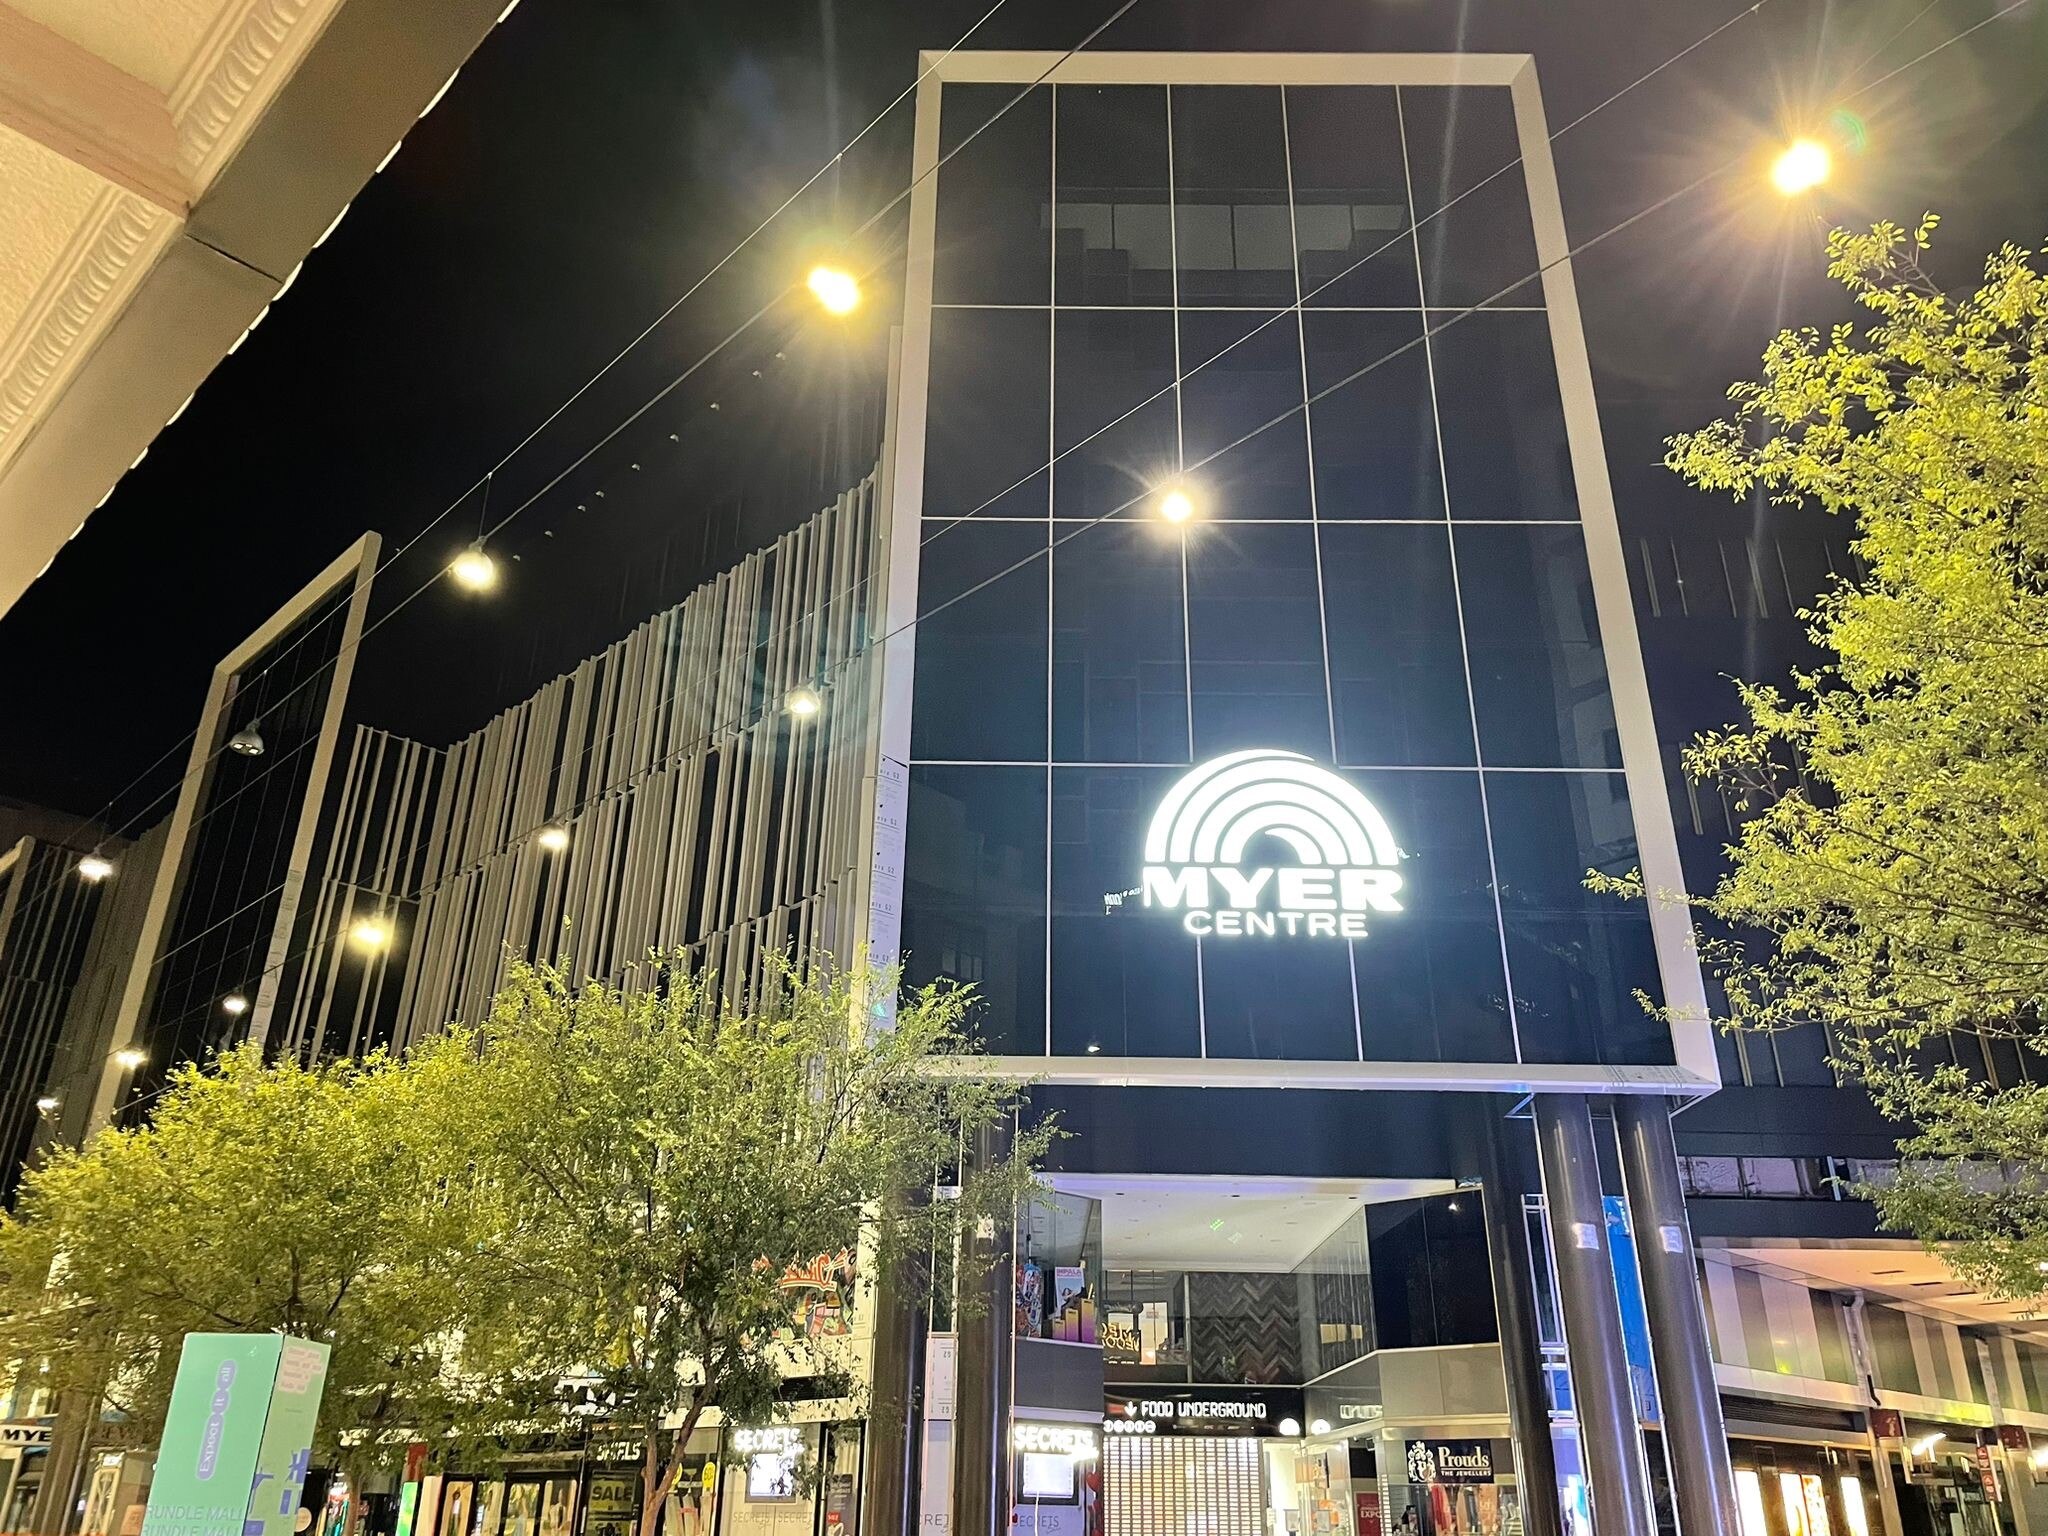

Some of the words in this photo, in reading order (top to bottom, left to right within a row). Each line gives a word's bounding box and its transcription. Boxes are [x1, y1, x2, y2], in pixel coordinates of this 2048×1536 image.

[1142, 866, 1405, 912] MYER
[1183, 911, 1369, 937] CENTRE
[1141, 1401, 1174, 1417] FOOD
[1178, 1402, 1267, 1418] UNDERGROUND
[3, 1428, 52, 1441] MYE
[735, 1428, 801, 1452] SECRETS
[1015, 1425, 1094, 1452] SECRETS
[1437, 1446, 1490, 1468] Prouds
[592, 1486, 633, 1501] SALE
[147, 1505, 204, 1521] RUNDLE
[206, 1507, 244, 1521] MALL
[778, 1512, 813, 1523] SECRET
[1014, 1514, 1060, 1528] ECETS
